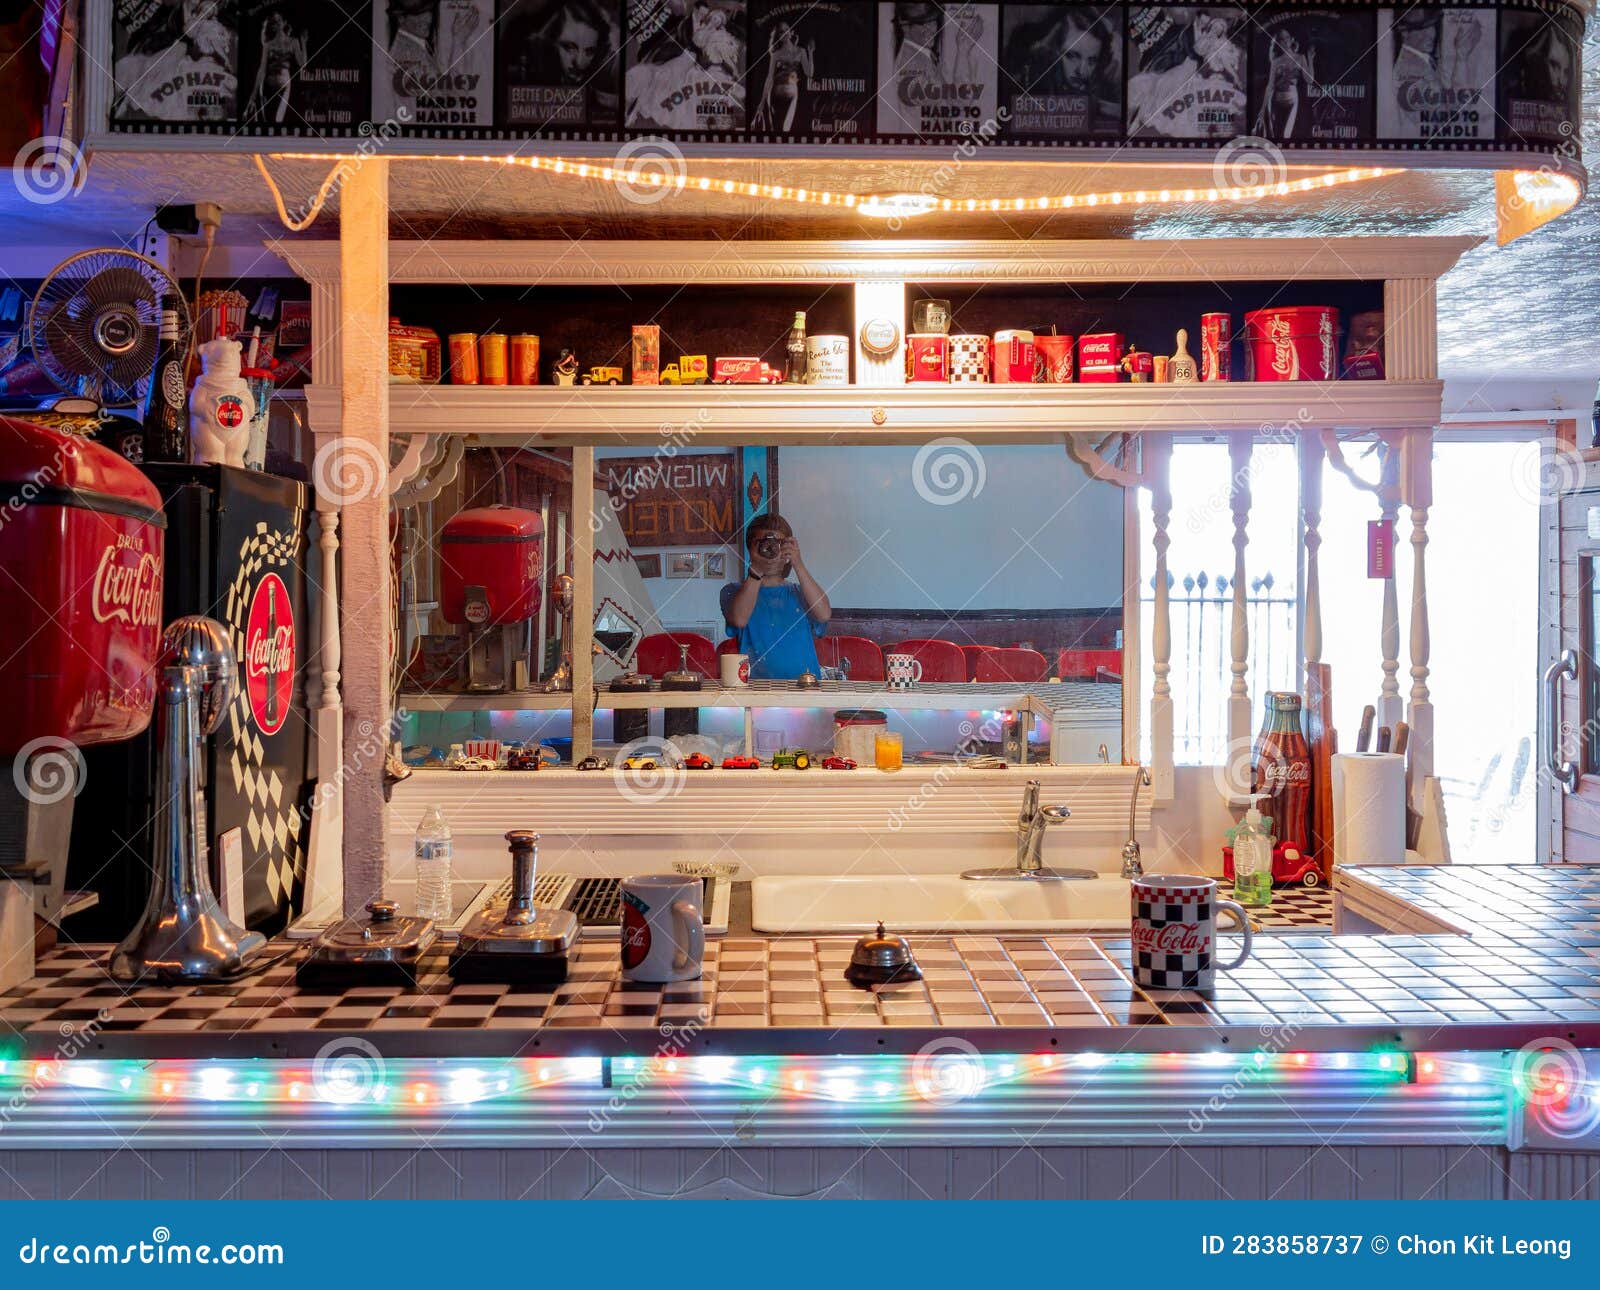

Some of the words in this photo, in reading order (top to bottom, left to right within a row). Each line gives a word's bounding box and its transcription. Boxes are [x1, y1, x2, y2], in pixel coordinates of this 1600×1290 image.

[151, 76, 184, 103] TOP
[186, 72, 225, 87] HAT
[511, 87, 541, 102] BETTE
[543, 87, 584, 102] DAVIS
[415, 97, 457, 109] HARD
[459, 97, 477, 109] TO
[660, 84, 694, 112] TOP
[695, 81, 736, 97] HAT
[1162, 91, 1195, 120] TOP
[1196, 88, 1234, 105] HAT
[511, 105, 538, 120] DARK
[540, 105, 584, 120] VICTORY
[696, 105, 734, 115] BERLIN
[921, 106, 963, 118] HARD
[965, 106, 981, 118] TO
[1047, 98, 1086, 112] DAVIS
[415, 111, 477, 124] HANDLE
[1043, 115, 1085, 129] VICTORY
[1197, 113, 1235, 123] BERLIN
[1420, 110, 1459, 123] HARD
[1462, 110, 1479, 123] TO
[1420, 125, 1479, 138] HANDLE
[1271, 314, 1291, 375] Coca-Cola
[1176, 368, 1191, 378] 66
[117, 534, 144, 550] DRINK
[91, 545, 161, 626] Coca-Cola
[249, 625, 293, 678] Coca-Cola
[1265, 761, 1309, 780] Coca-Cola
[1132, 918, 1202, 951] Coca-Cola
